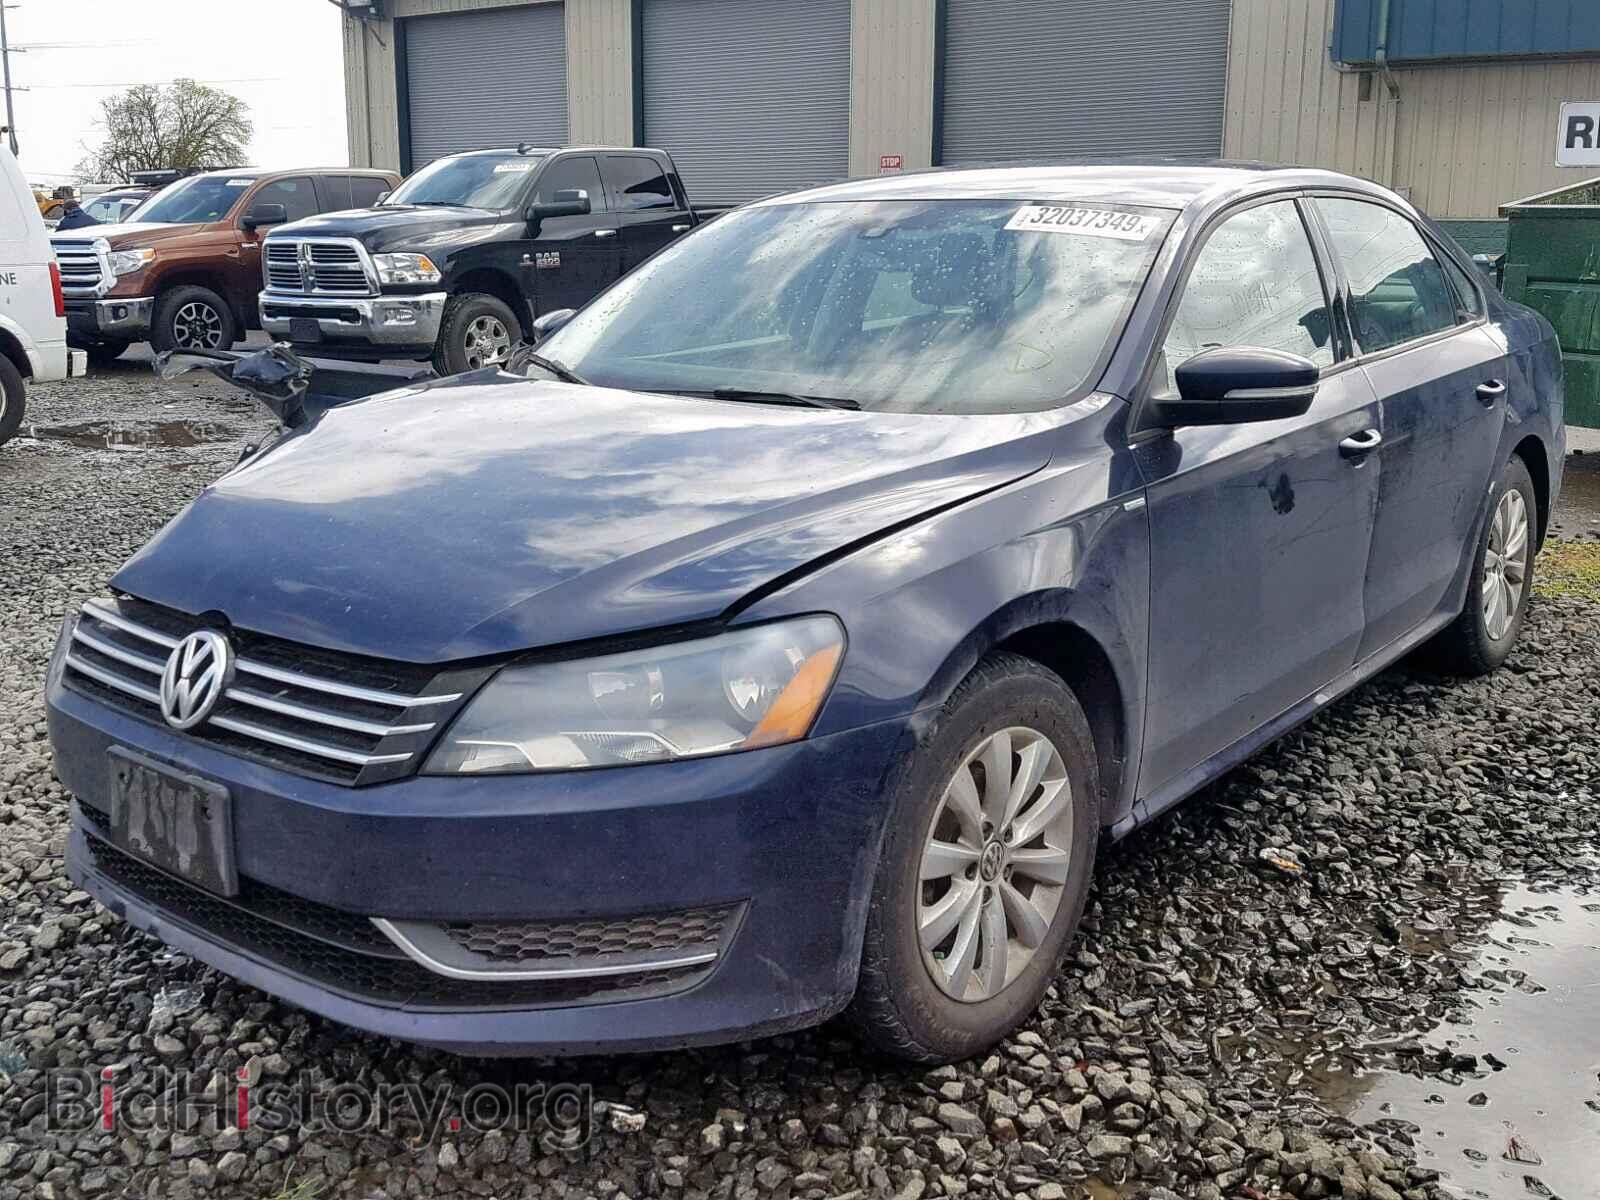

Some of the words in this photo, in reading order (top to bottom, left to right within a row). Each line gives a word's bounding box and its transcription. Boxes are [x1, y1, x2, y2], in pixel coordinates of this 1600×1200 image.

[1565, 115, 1600, 149] R
[882, 157, 900, 167] STOP
[1030, 206, 1142, 233] 32037349
